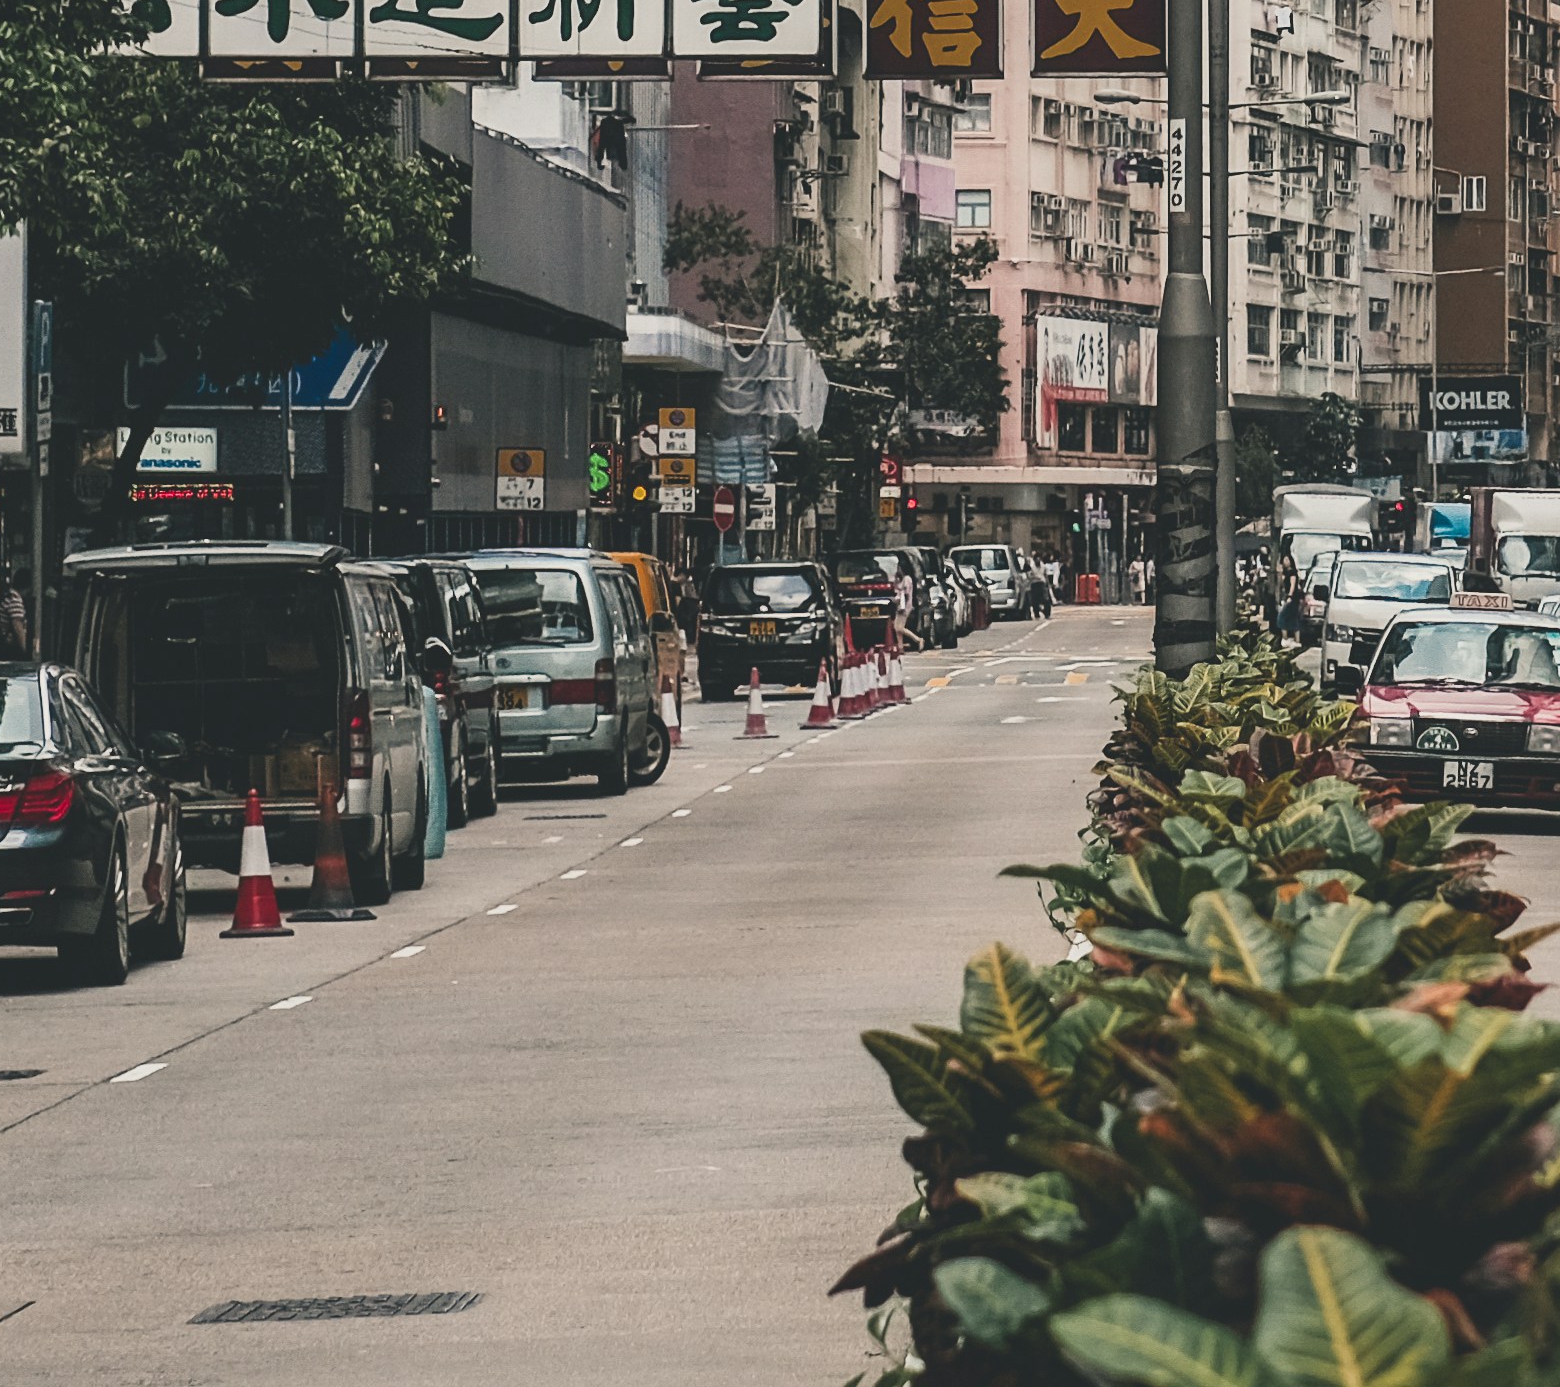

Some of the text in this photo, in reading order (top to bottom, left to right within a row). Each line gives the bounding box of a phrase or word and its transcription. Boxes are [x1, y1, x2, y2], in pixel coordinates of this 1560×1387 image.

[1171, 127, 1183, 207] 44270
[1428, 390, 1512, 411] KOHLER
[164, 430, 214, 445] Station
[140, 456, 202, 469] anasonic
[1454, 595, 1509, 609] TAXI
[1457, 761, 1479, 776] NZ
